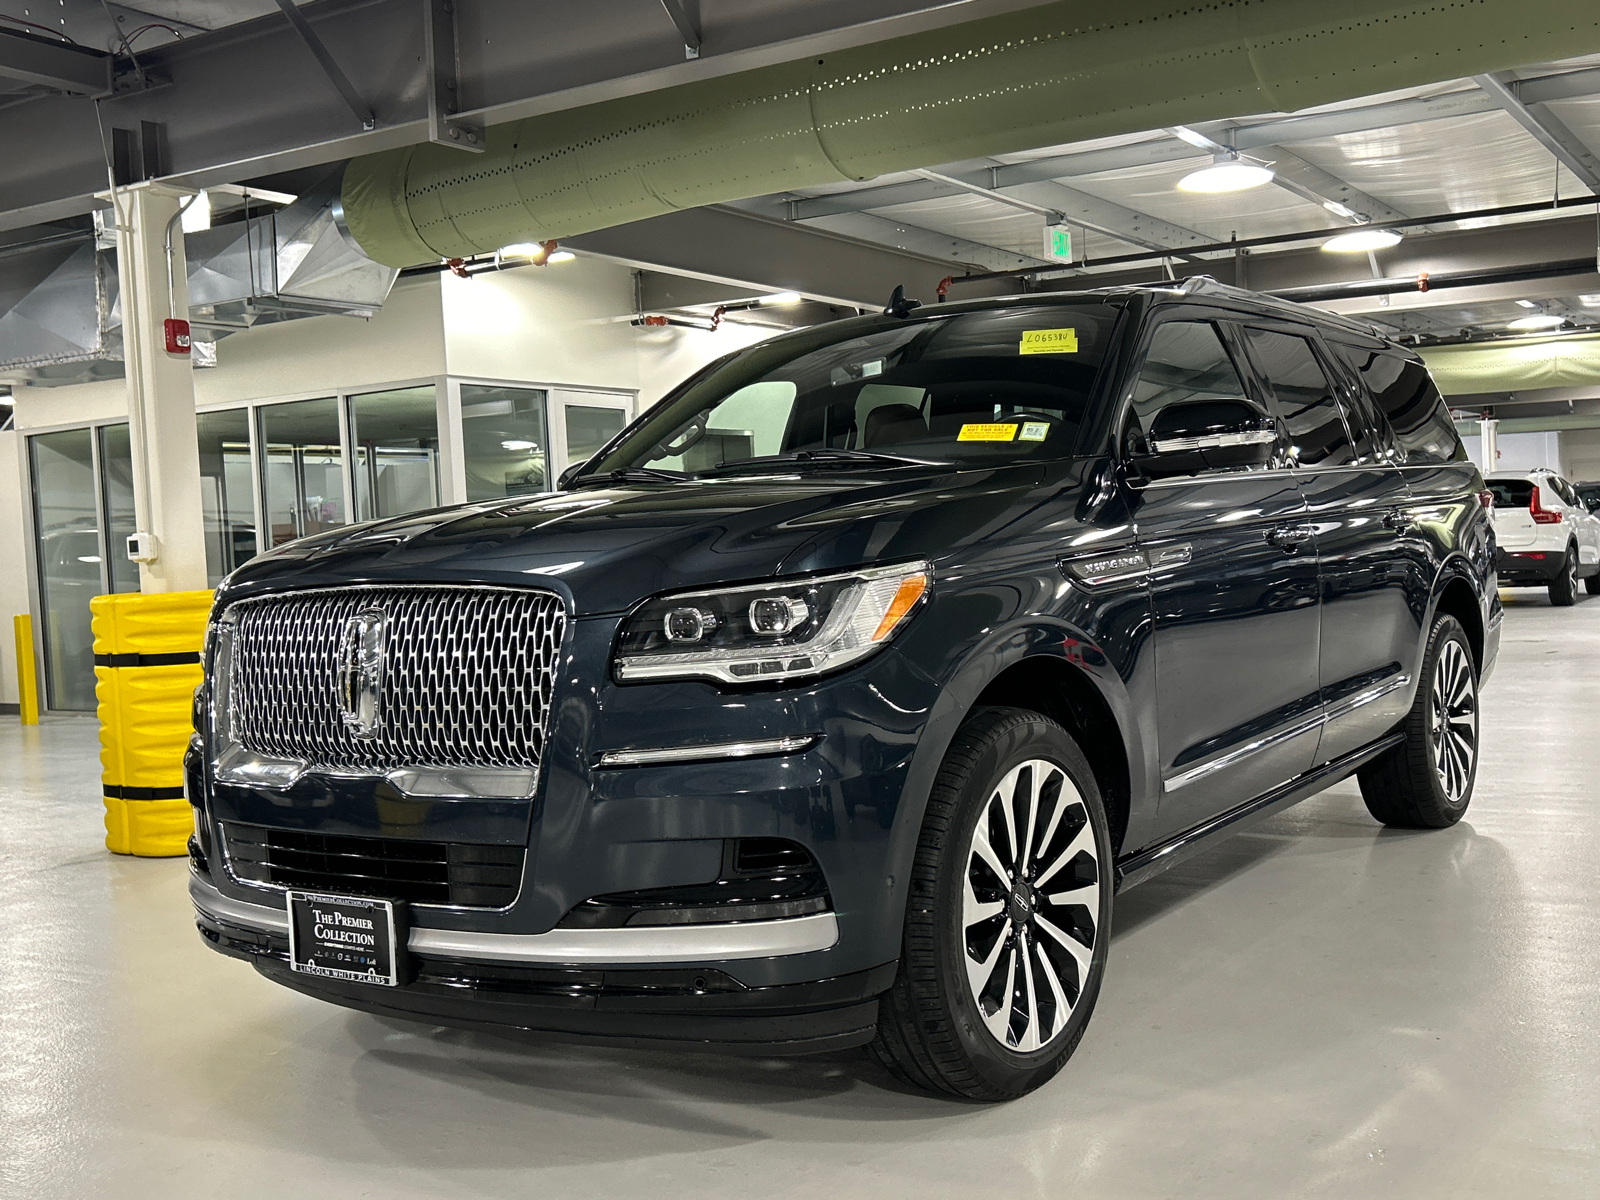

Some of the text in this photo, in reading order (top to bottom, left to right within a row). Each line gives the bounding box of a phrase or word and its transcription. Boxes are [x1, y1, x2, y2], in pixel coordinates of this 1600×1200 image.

[312, 910, 374, 930] THE PREMIER
[314, 924, 374, 946] COLLECTION
[300, 965, 385, 984] LINCOLN WHITE PLAINS
